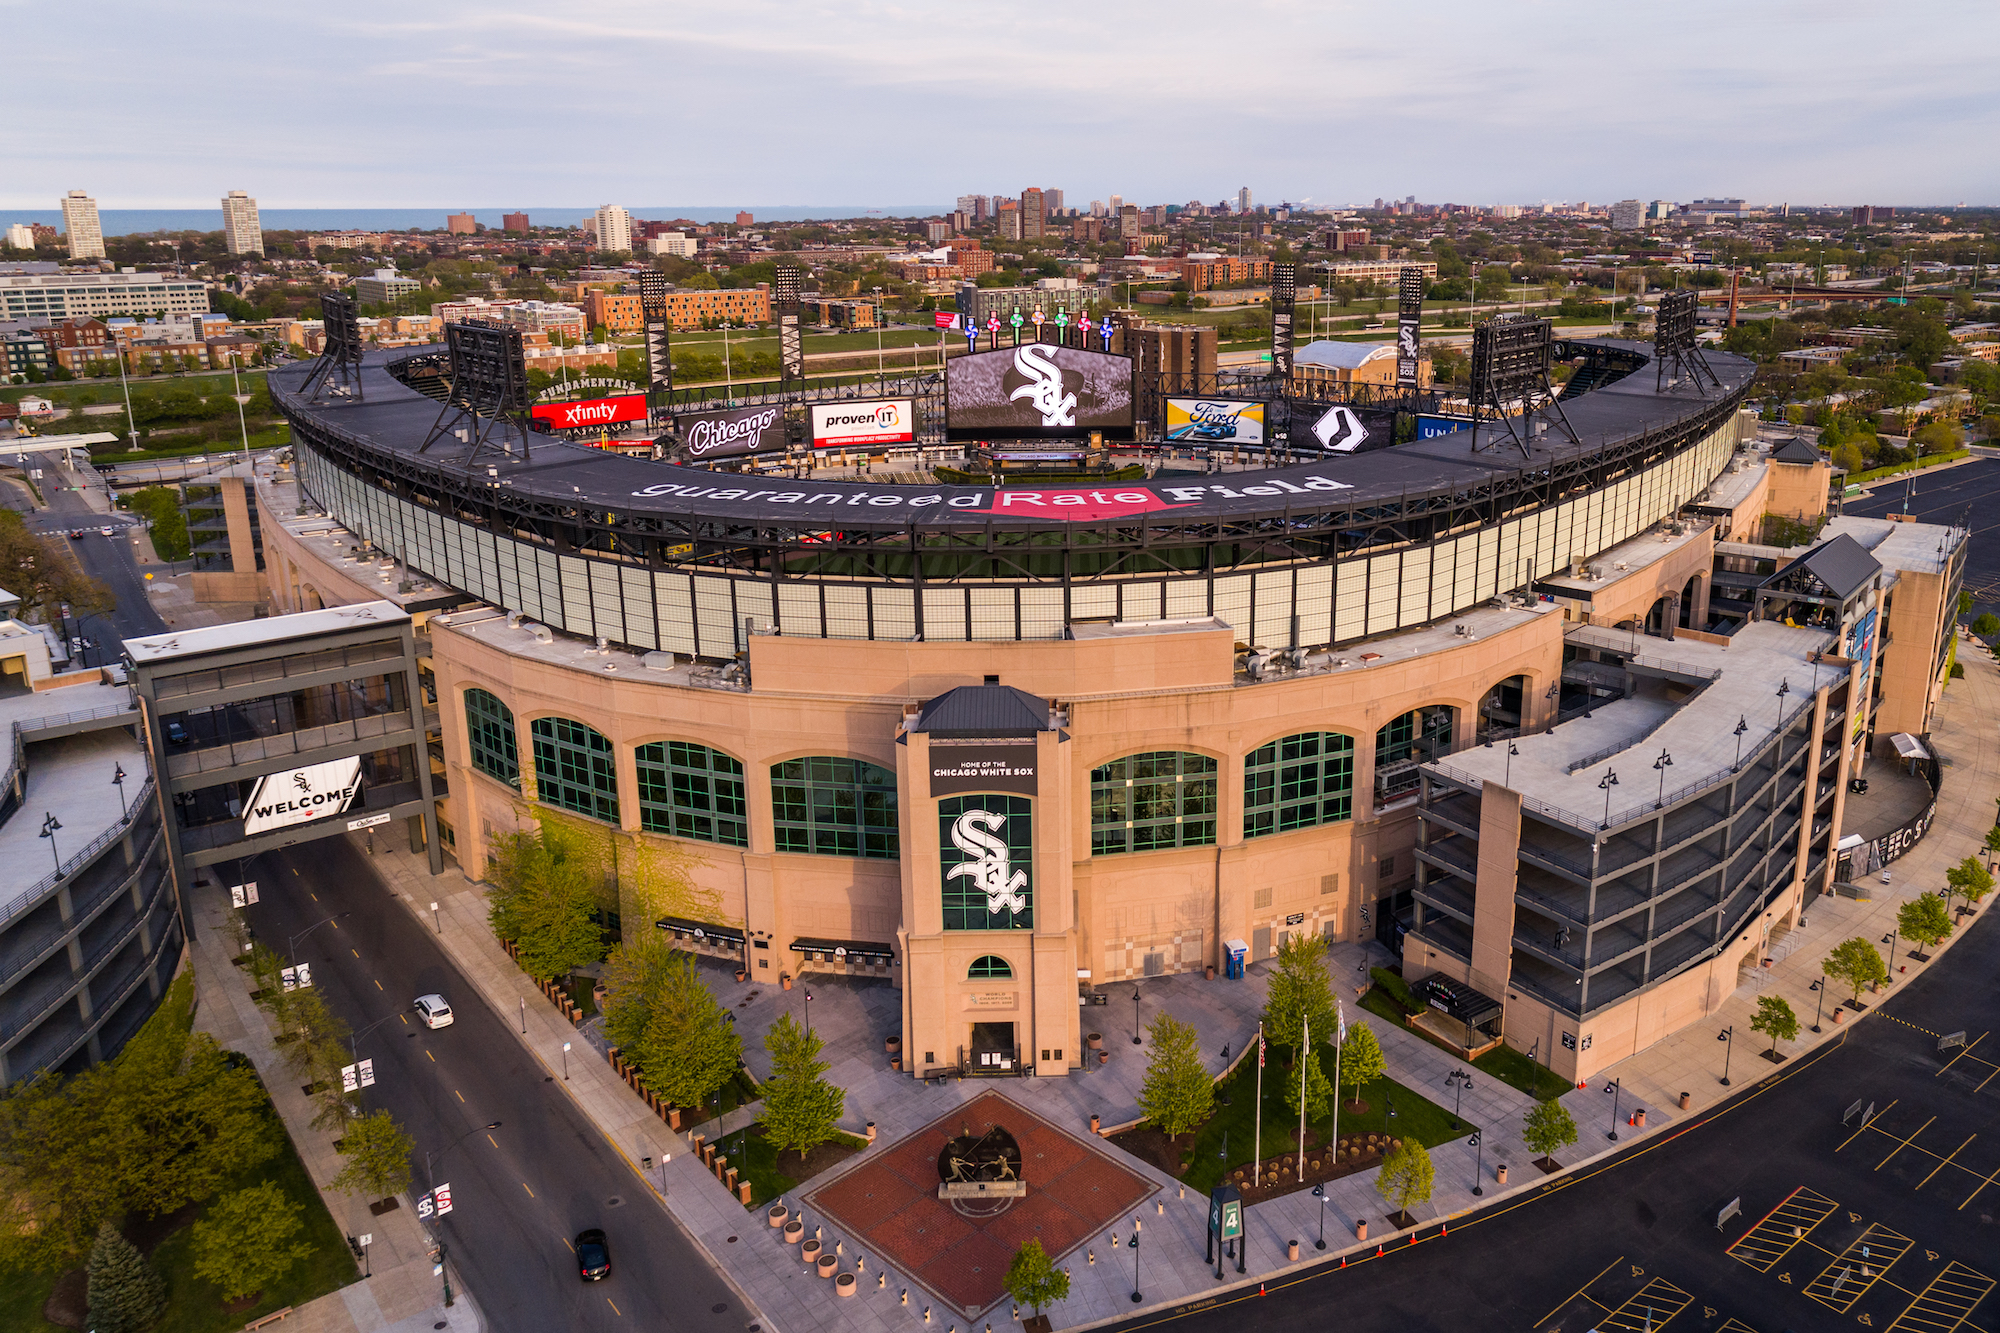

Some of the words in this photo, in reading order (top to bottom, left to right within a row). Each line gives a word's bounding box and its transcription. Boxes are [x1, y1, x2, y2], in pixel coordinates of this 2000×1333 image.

[540, 378, 636, 400] FUNDAMENTALS
[565, 403, 617, 424] xfinity
[825, 414, 875, 428] proven
[882, 411, 893, 422] IT
[1189, 402, 1241, 426] Ford
[688, 408, 776, 456] Chicago
[631, 483, 983, 507] guaranteed
[1002, 491, 1149, 507] Rate
[1161, 475, 1355, 501] Field
[254, 787, 354, 818] WELCOME
[1212, 1209, 1218, 1225] 4
[1226, 1212, 1237, 1228] 4
[1176, 1306, 1185, 1314] NO
[1188, 1298, 1216, 1310] PARKING
